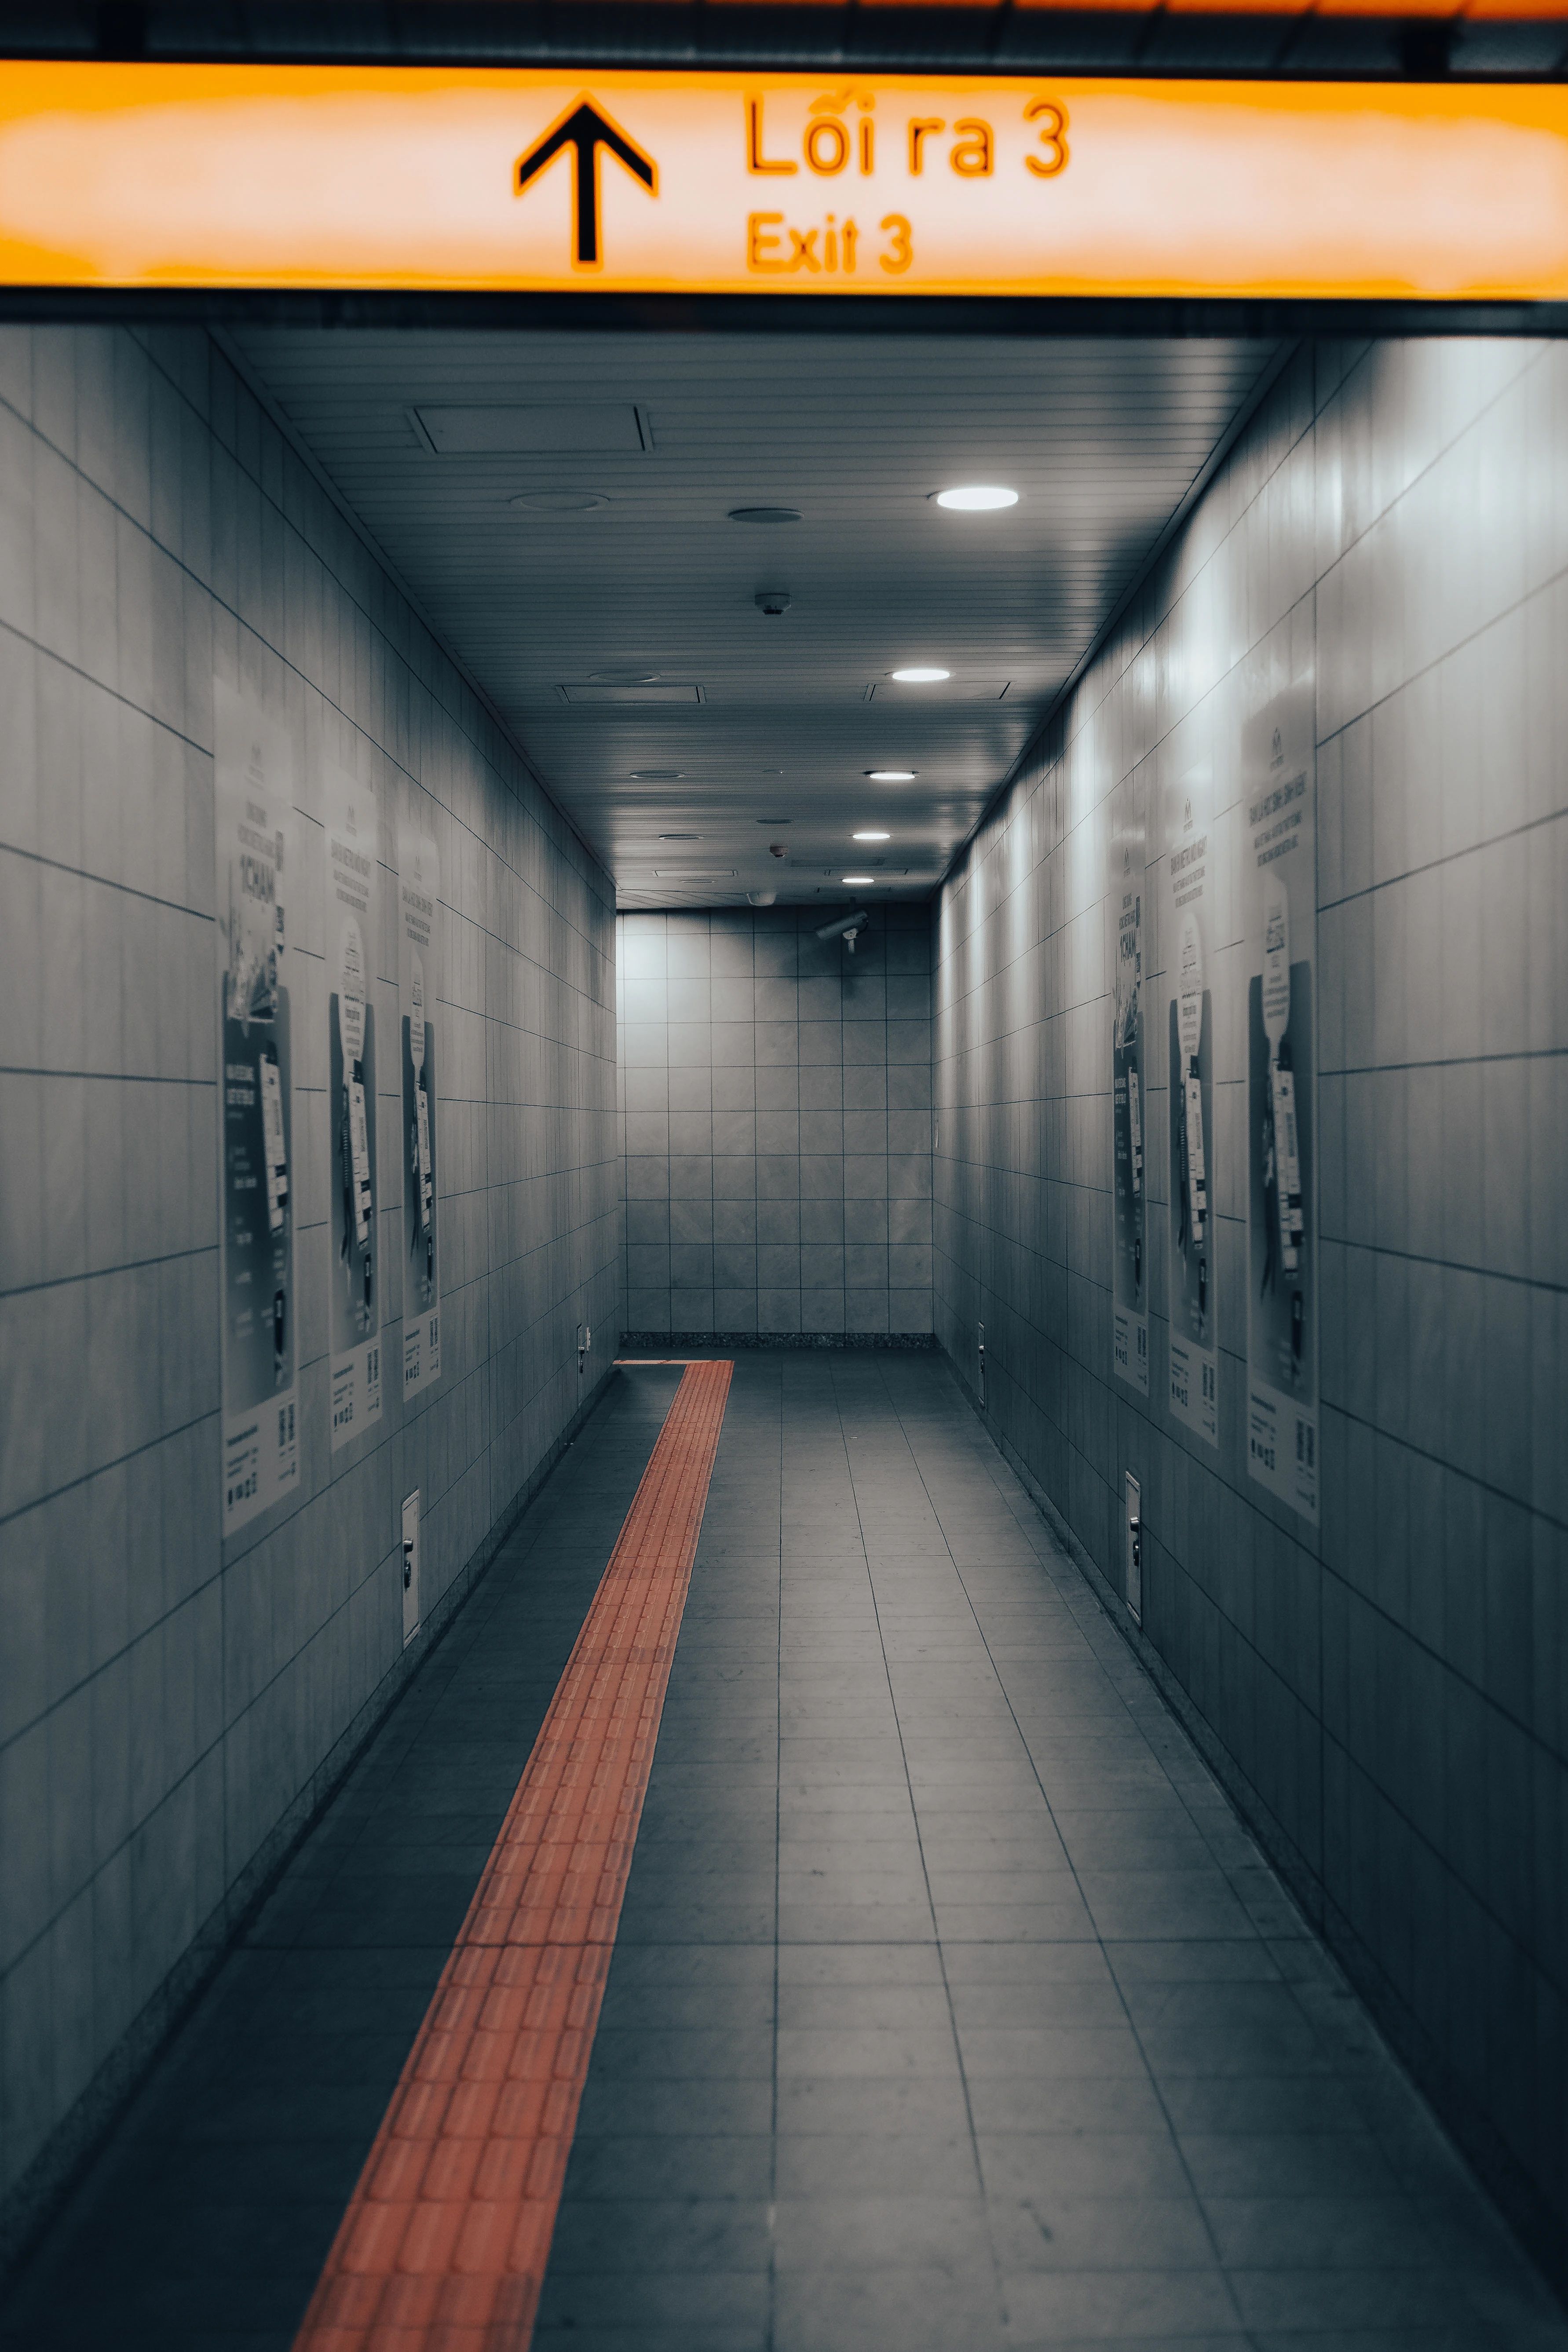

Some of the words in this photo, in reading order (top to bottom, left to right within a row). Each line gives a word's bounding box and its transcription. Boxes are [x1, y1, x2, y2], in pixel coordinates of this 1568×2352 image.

[745, 87, 876, 176] Lối
[909, 118, 993, 177] ra
[1023, 94, 1070, 178] 3
[747, 211, 859, 273] Exit
[879, 213, 913, 274] 3
